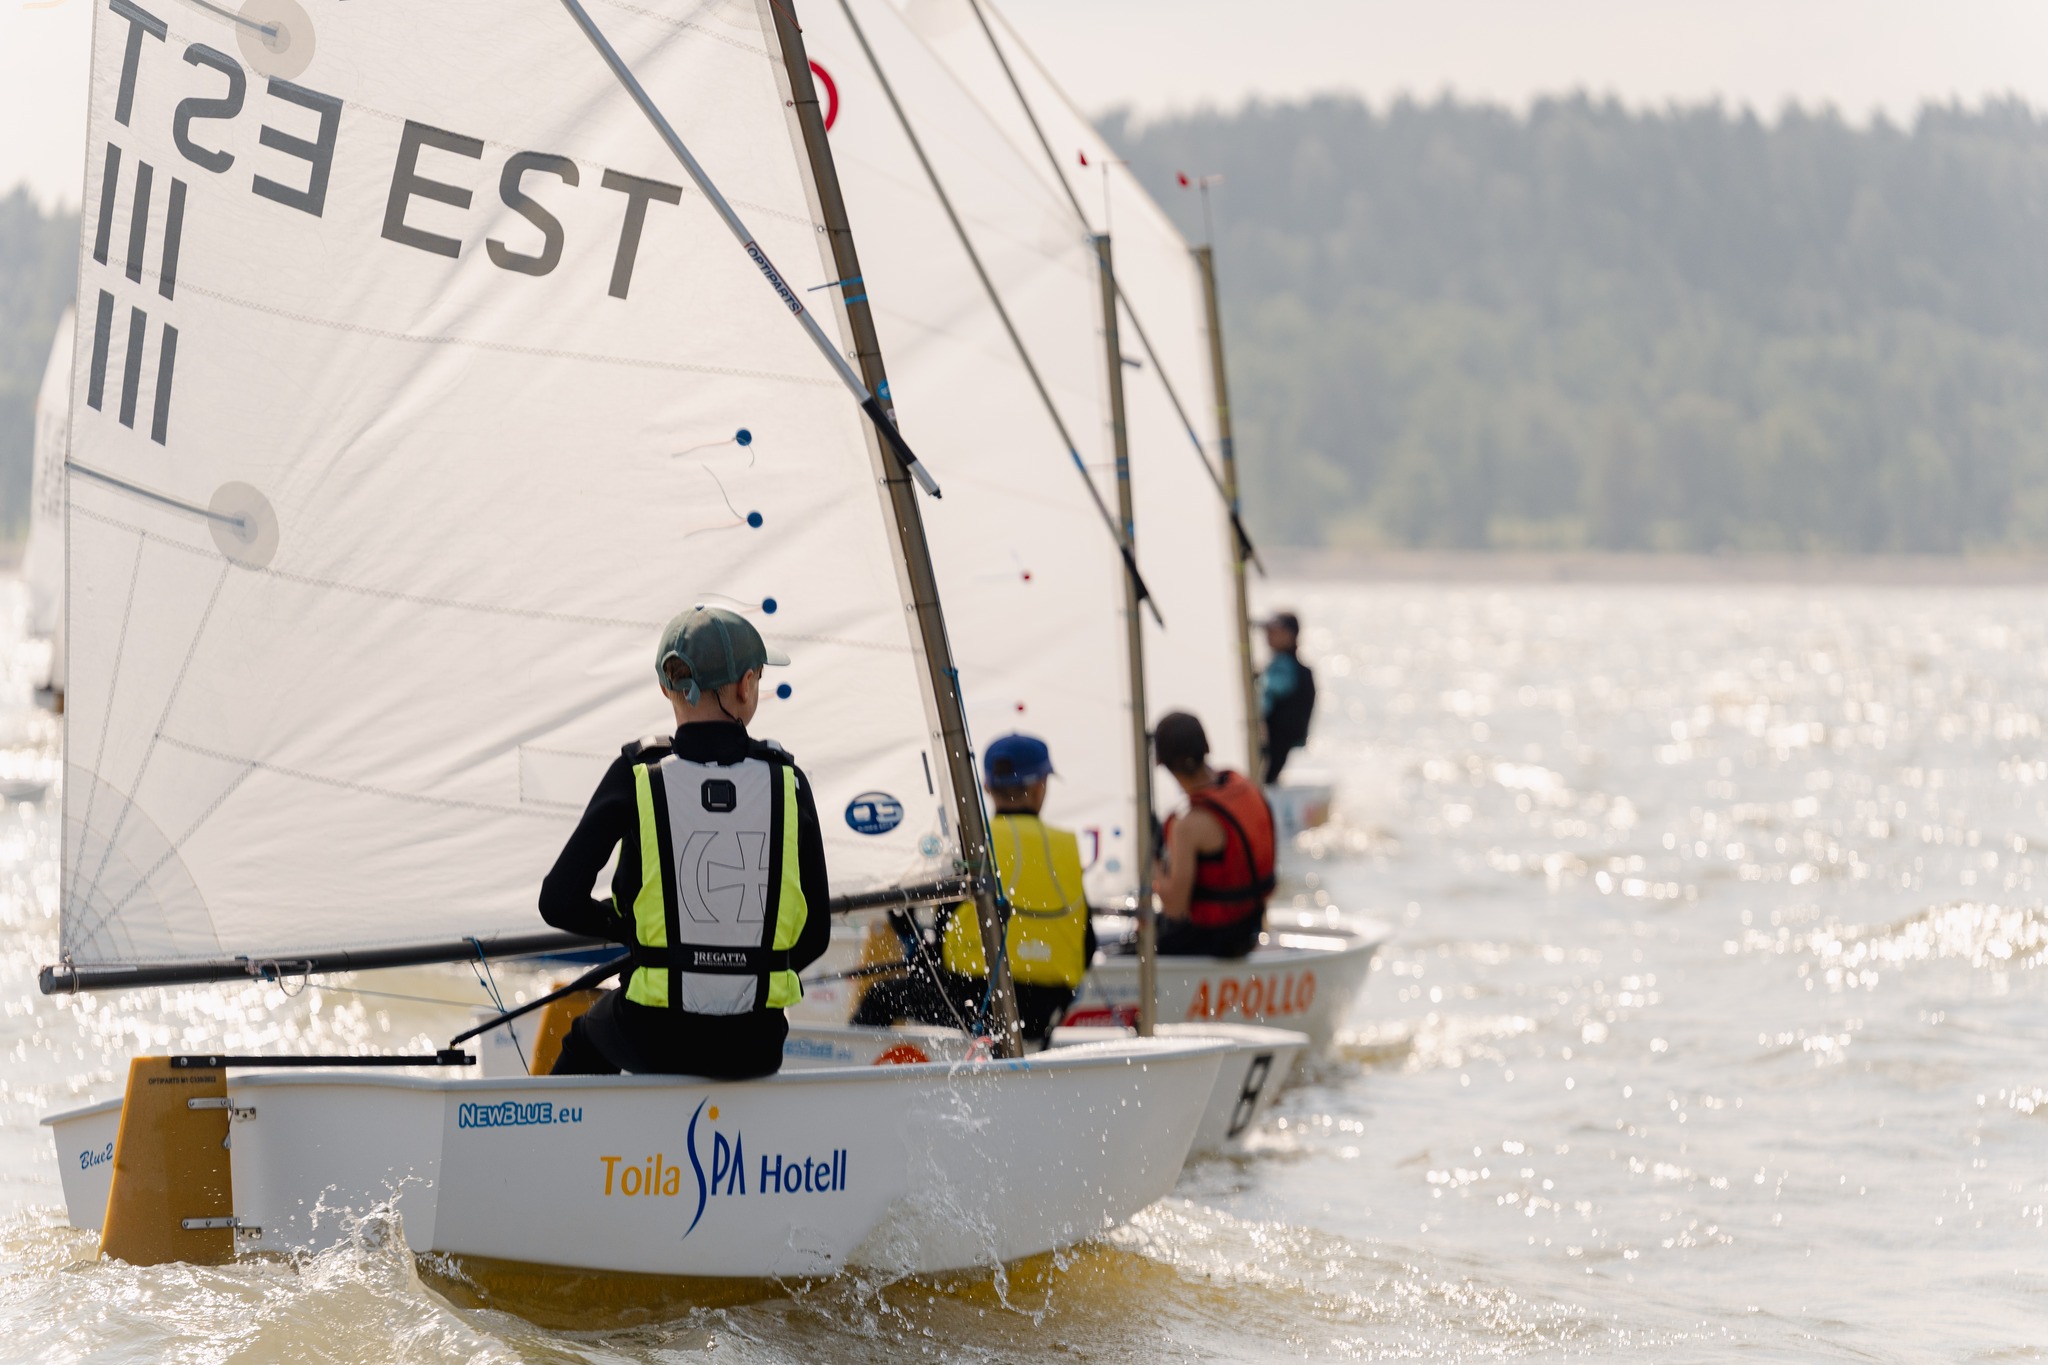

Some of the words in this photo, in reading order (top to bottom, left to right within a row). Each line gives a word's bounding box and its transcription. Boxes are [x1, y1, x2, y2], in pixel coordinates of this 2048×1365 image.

[381, 119, 683, 300] EST
[747, 247, 800, 312] OPTIPARTS
[699, 951, 747, 962] REGATTA
[1185, 970, 1317, 1021] APOLLO
[600, 1154, 681, 1196] Toila
[682, 1095, 746, 1241] SPA
[760, 1149, 847, 1193] Hotell
